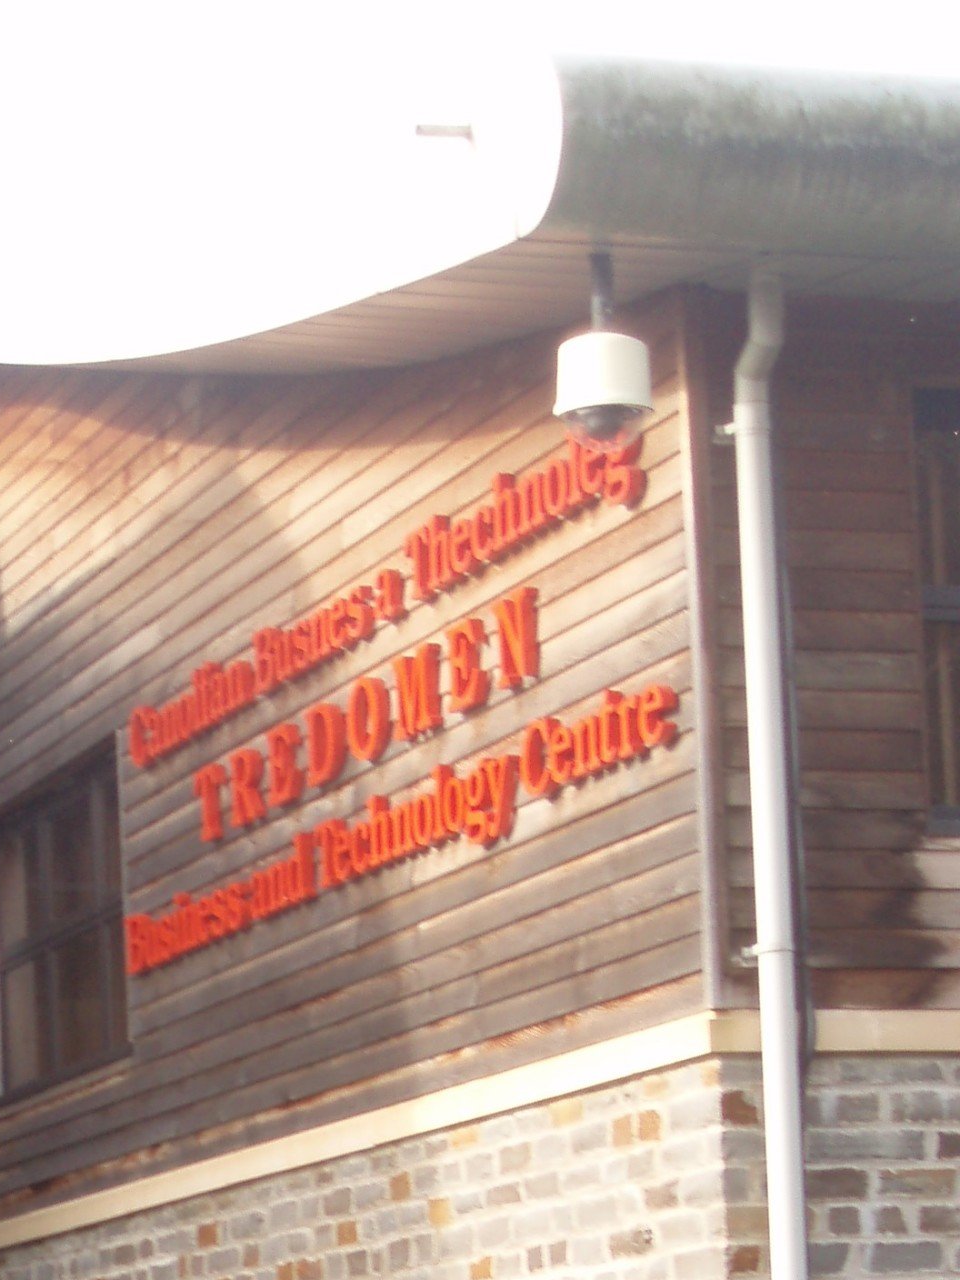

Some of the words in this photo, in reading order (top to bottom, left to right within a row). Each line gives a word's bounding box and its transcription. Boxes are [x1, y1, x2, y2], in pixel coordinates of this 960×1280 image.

[251, 586, 377, 696] Busnes
[375, 568, 406, 621] a
[405, 424, 648, 601] Thechnoleg
[124, 882, 254, 976] Business
[250, 832, 318, 920] and
[310, 754, 520, 890] Technology
[519, 684, 679, 797] Centre
[193, 587, 539, 842] TREDOMEN
